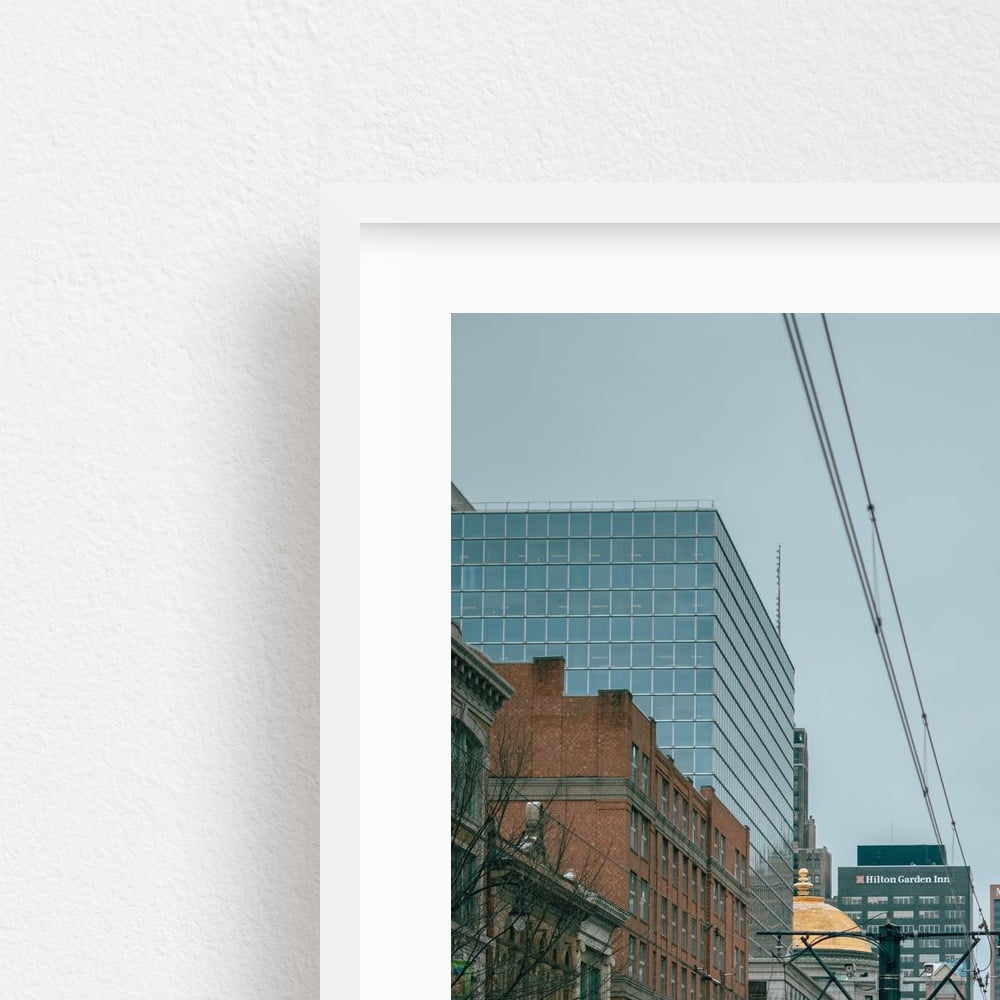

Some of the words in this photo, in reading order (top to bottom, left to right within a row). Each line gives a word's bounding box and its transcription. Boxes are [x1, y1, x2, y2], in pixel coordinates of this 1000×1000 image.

[865, 875, 897, 884] Hilton
[898, 875, 932, 884] Garden
[933, 875, 950, 884] Inn
